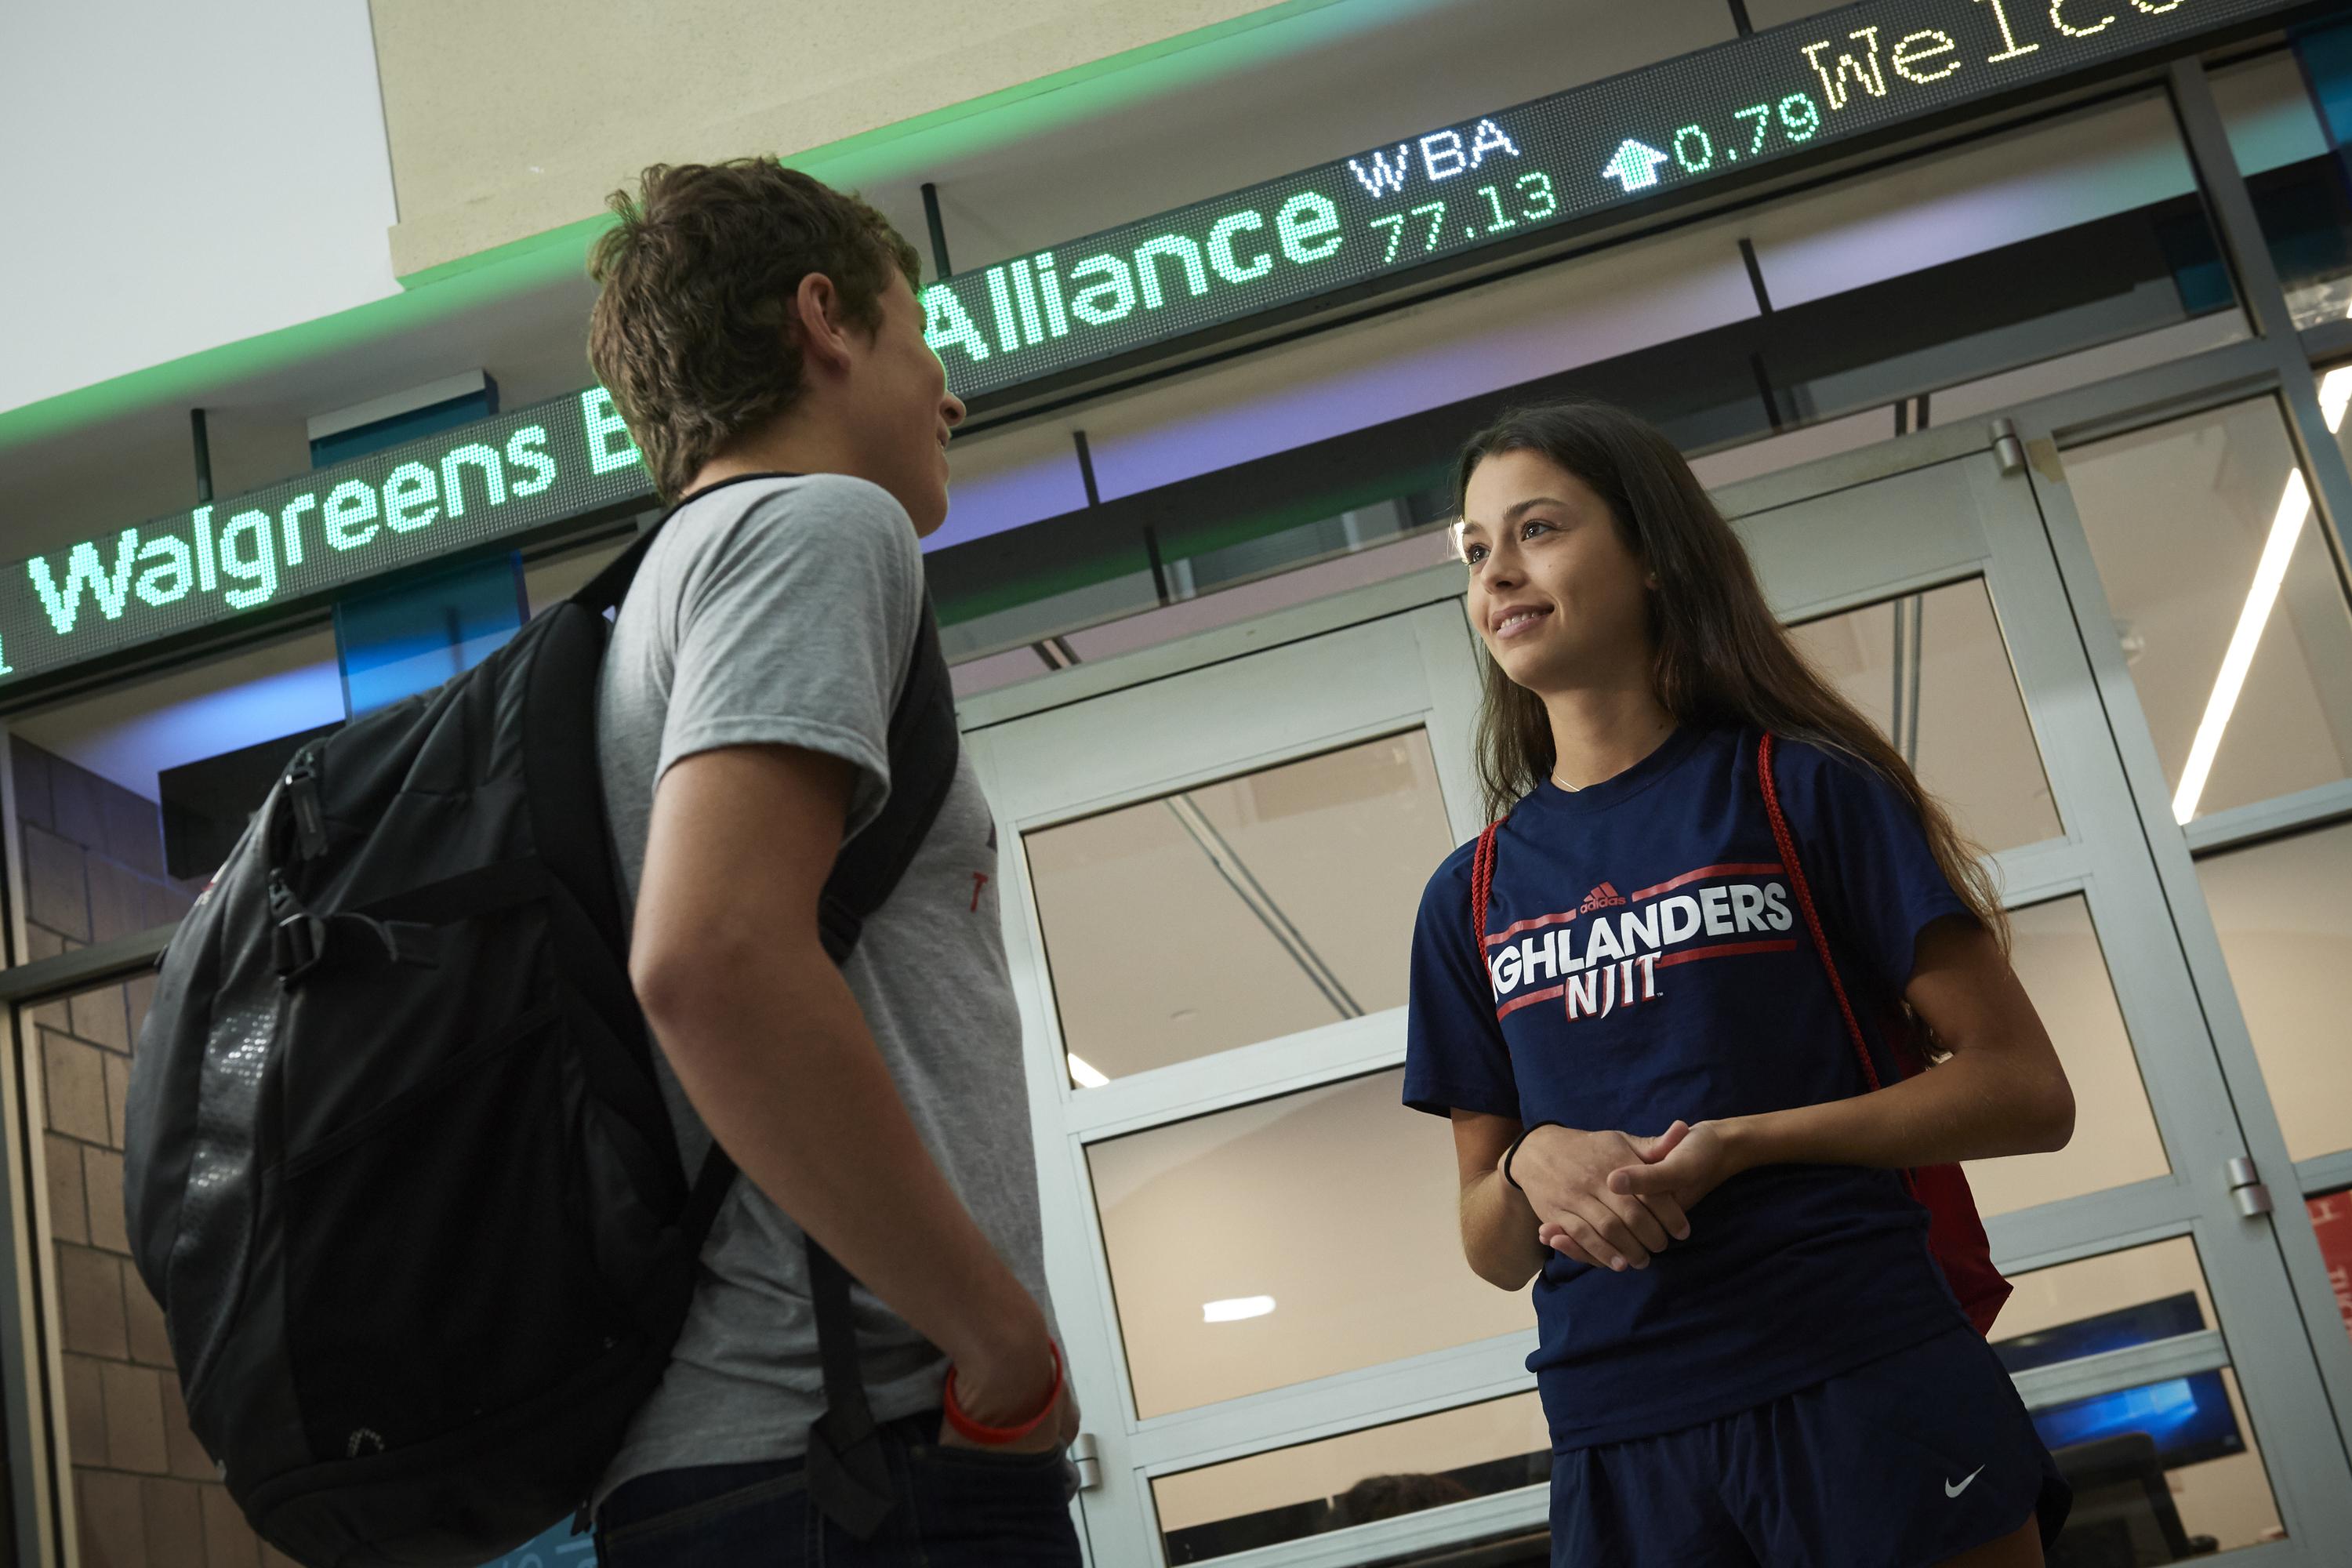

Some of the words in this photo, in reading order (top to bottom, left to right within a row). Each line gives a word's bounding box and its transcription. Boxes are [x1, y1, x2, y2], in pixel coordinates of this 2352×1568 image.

[1802, 0, 2184, 109] Welc
[1349, 119, 1520, 198] WBA
[1370, 171, 1555, 263] 77.13
[1675, 93, 1819, 172] 0.79
[28, 426, 557, 634] Walgreens
[924, 191, 1343, 361] Alliance
[1580, 896, 1627, 914] adidas
[1566, 951, 1662, 1022] NJIT
